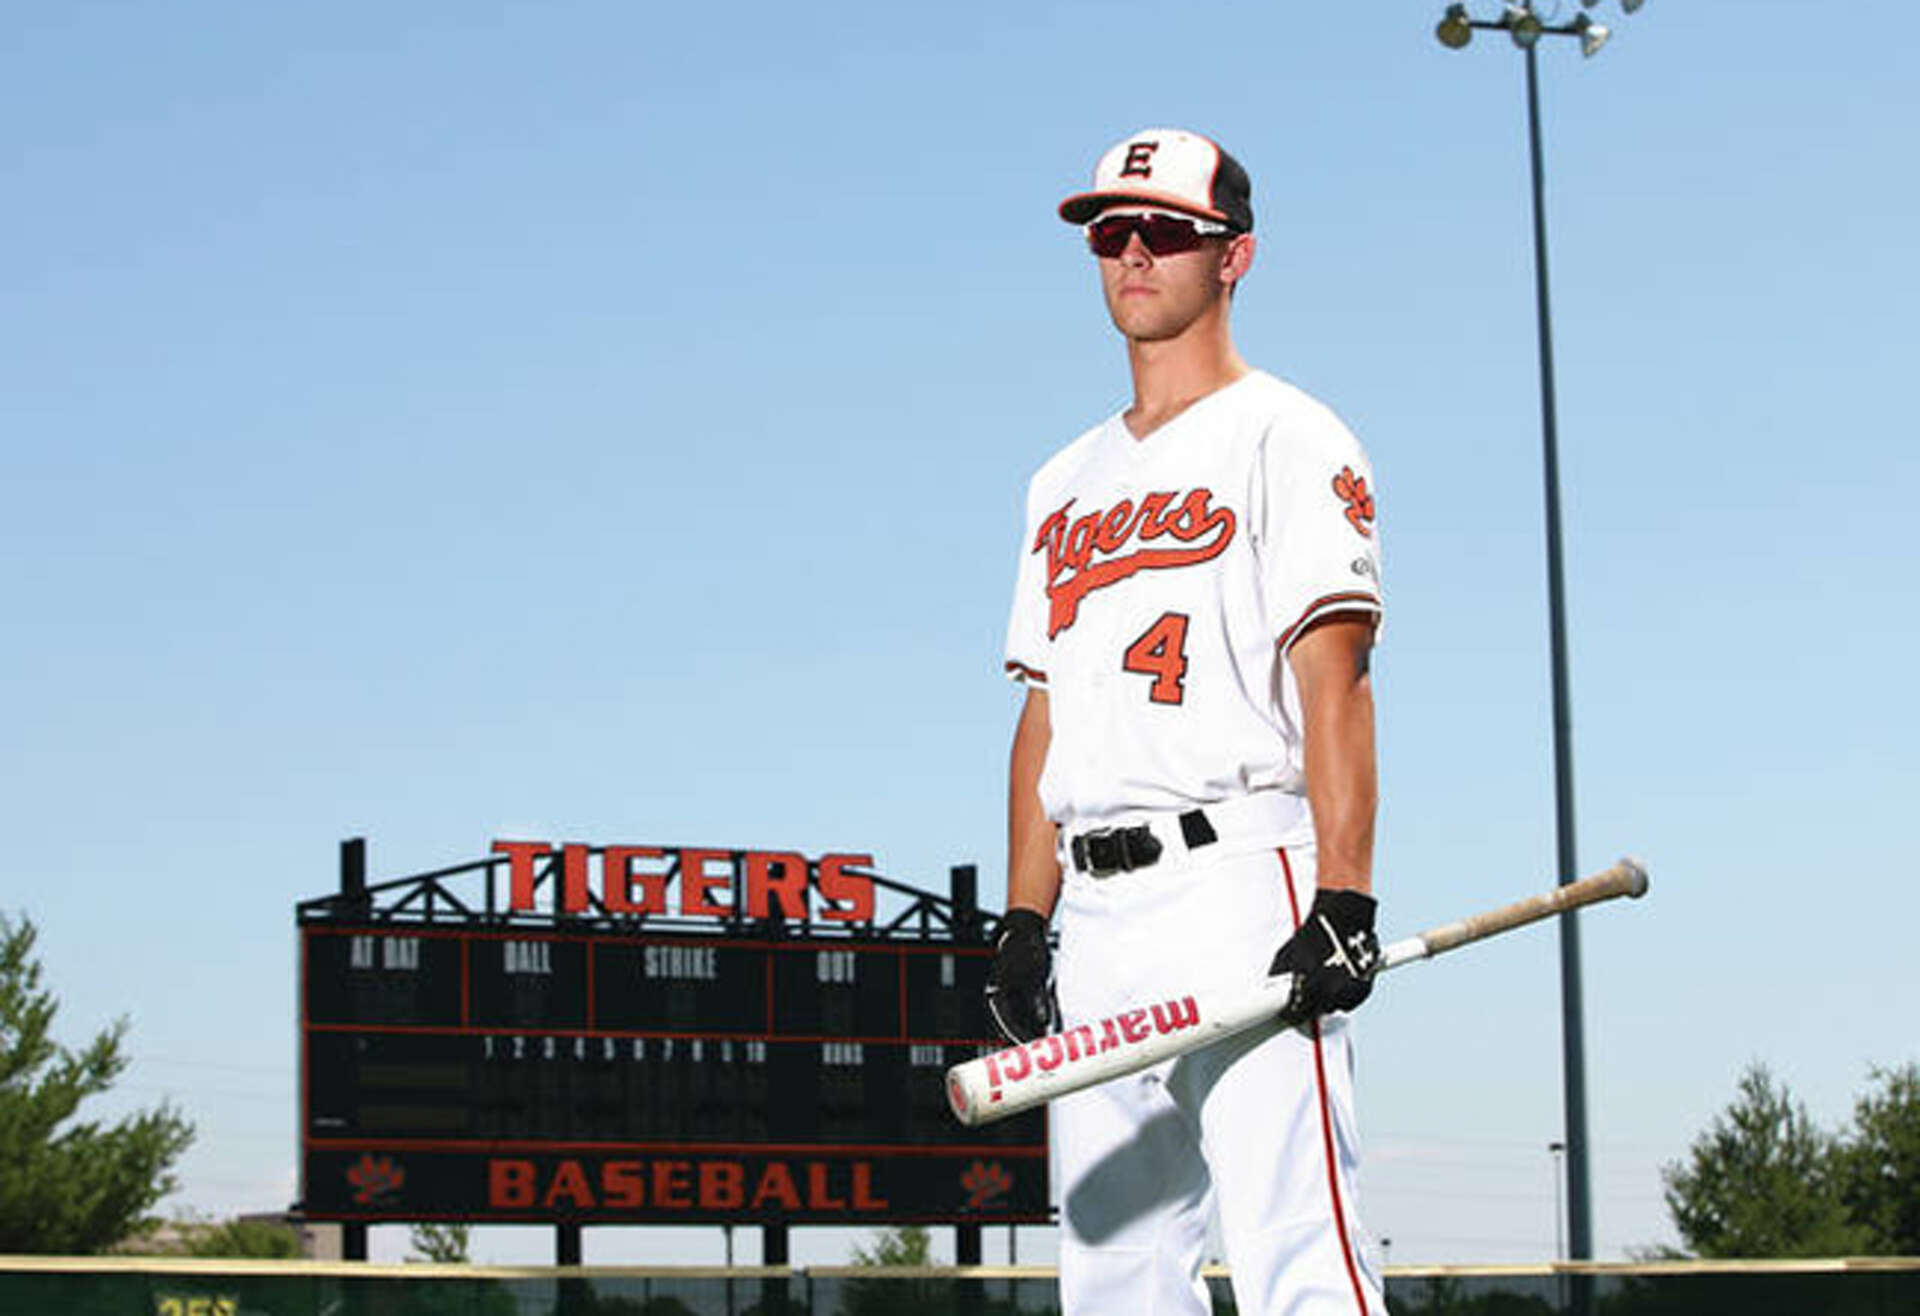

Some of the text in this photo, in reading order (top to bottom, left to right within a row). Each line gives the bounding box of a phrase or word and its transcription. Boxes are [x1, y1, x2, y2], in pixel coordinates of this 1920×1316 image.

[1119, 140, 1159, 179] E
[1122, 611, 1190, 706] 4
[491, 841, 876, 923] TIGERS
[350, 936, 374, 969] AT
[504, 940, 552, 974] BALL
[645, 945, 717, 979] STRIKE
[817, 950, 855, 983] OUT
[984, 994, 1200, 1103] marucci
[487, 1159, 889, 1210] BASEBALL
